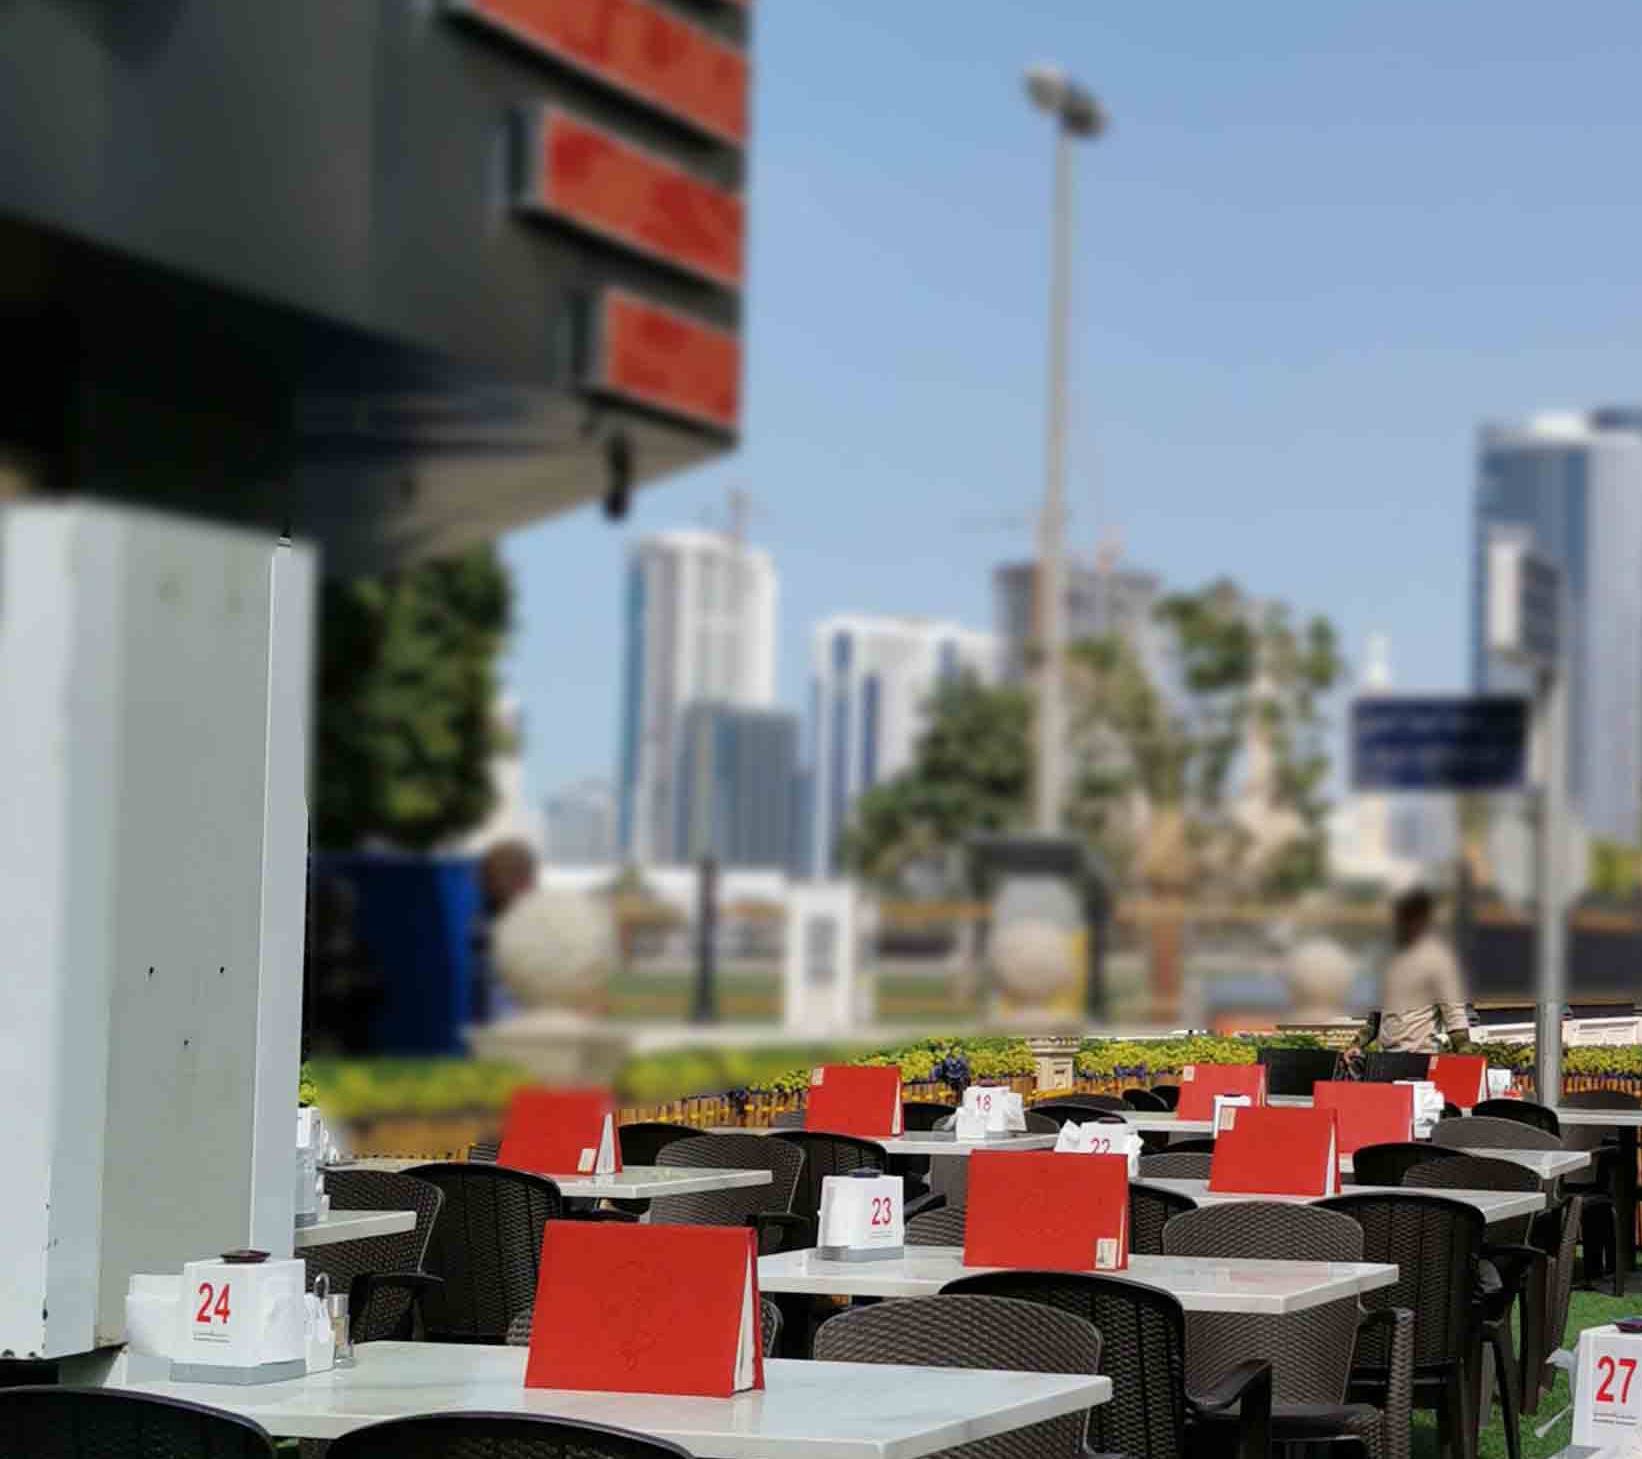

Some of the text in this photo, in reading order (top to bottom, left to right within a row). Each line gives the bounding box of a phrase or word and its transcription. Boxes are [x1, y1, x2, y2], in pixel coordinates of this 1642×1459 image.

[976, 1094, 992, 1110] 18
[872, 1197, 892, 1225] 23
[195, 1282, 231, 1324] 24
[1596, 1356, 1637, 1405] 27
